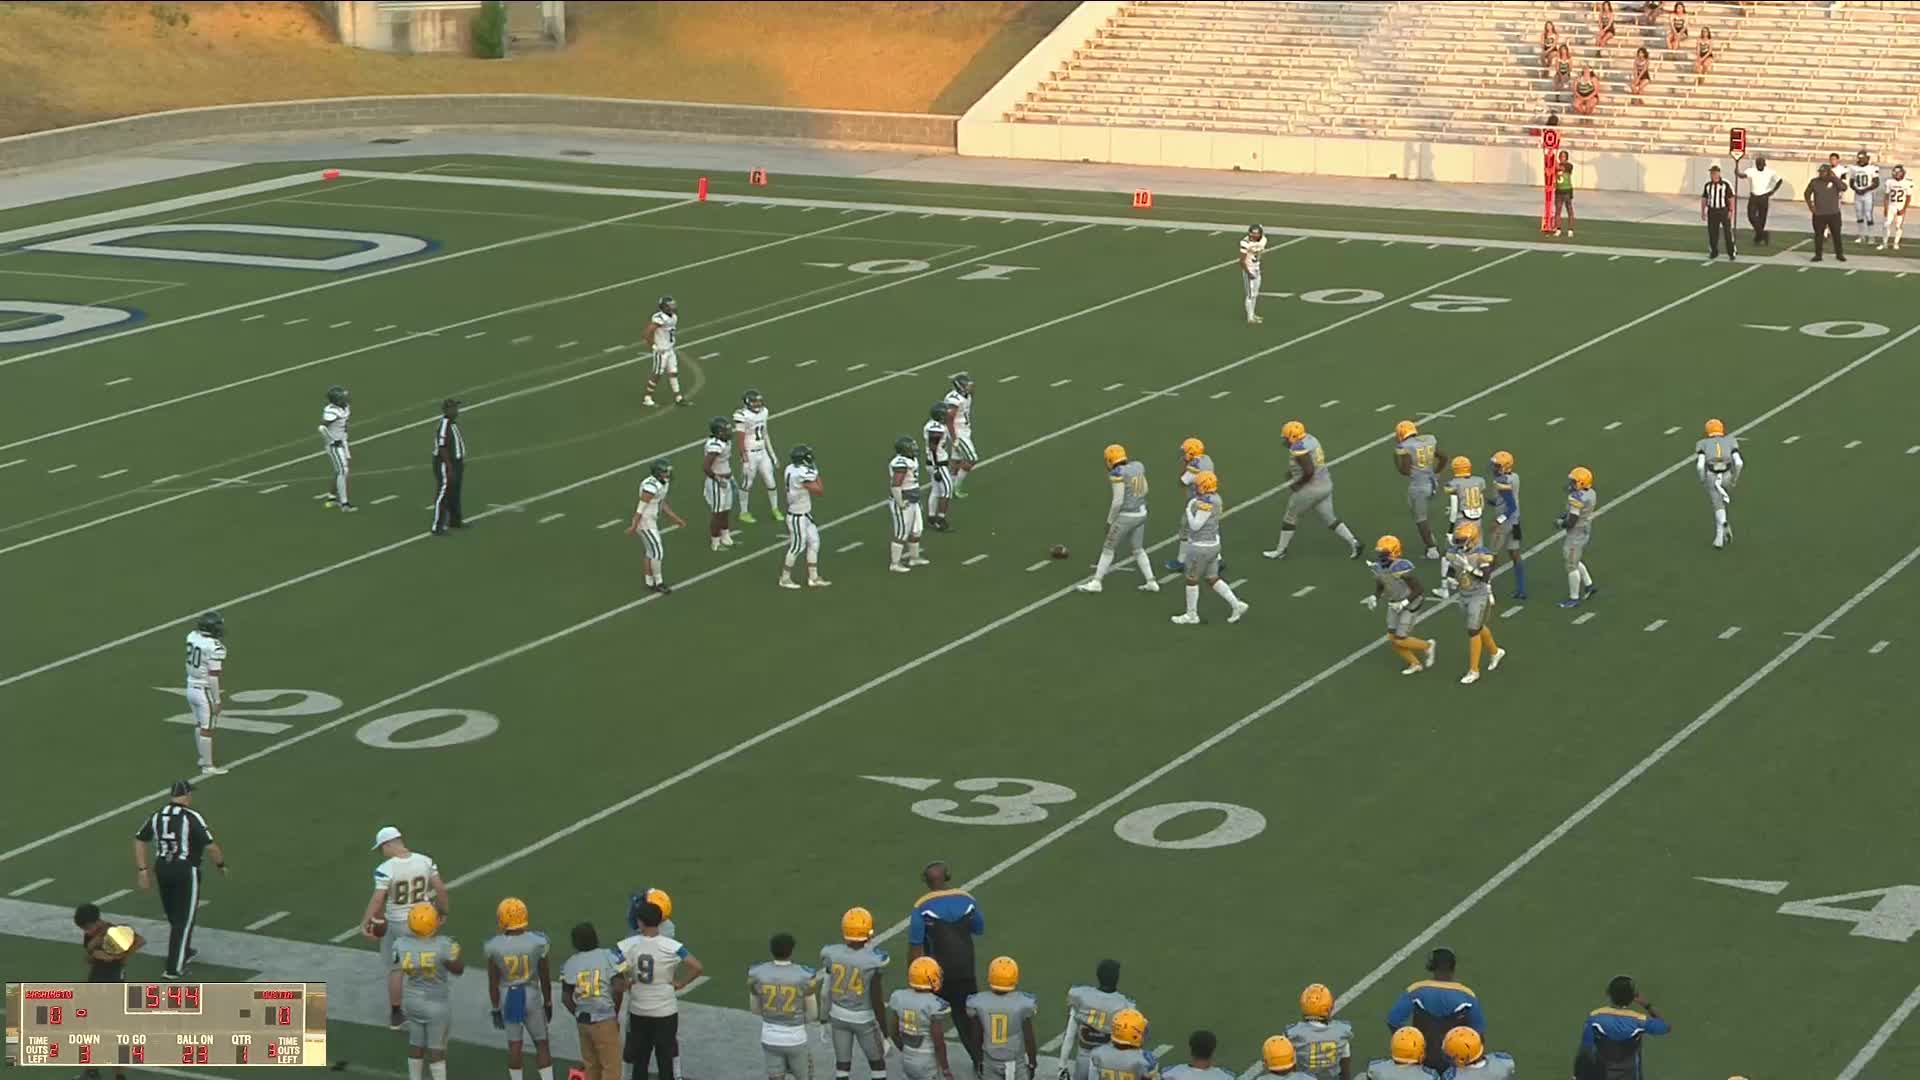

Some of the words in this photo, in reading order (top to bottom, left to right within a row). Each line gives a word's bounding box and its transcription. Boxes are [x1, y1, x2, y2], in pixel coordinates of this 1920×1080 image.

[1731, 128, 1745, 152] 3
[1136, 191, 1149, 205] 10
[1890, 189, 1905, 203] 22
[162, 815, 176, 839] L
[393, 876, 427, 905] 82
[503, 954, 531, 982] 21
[637, 954, 654, 985] 9
[831, 962, 865, 997] 24
[576, 968, 602, 1000] 51
[991, 1014, 1008, 1045] 0
